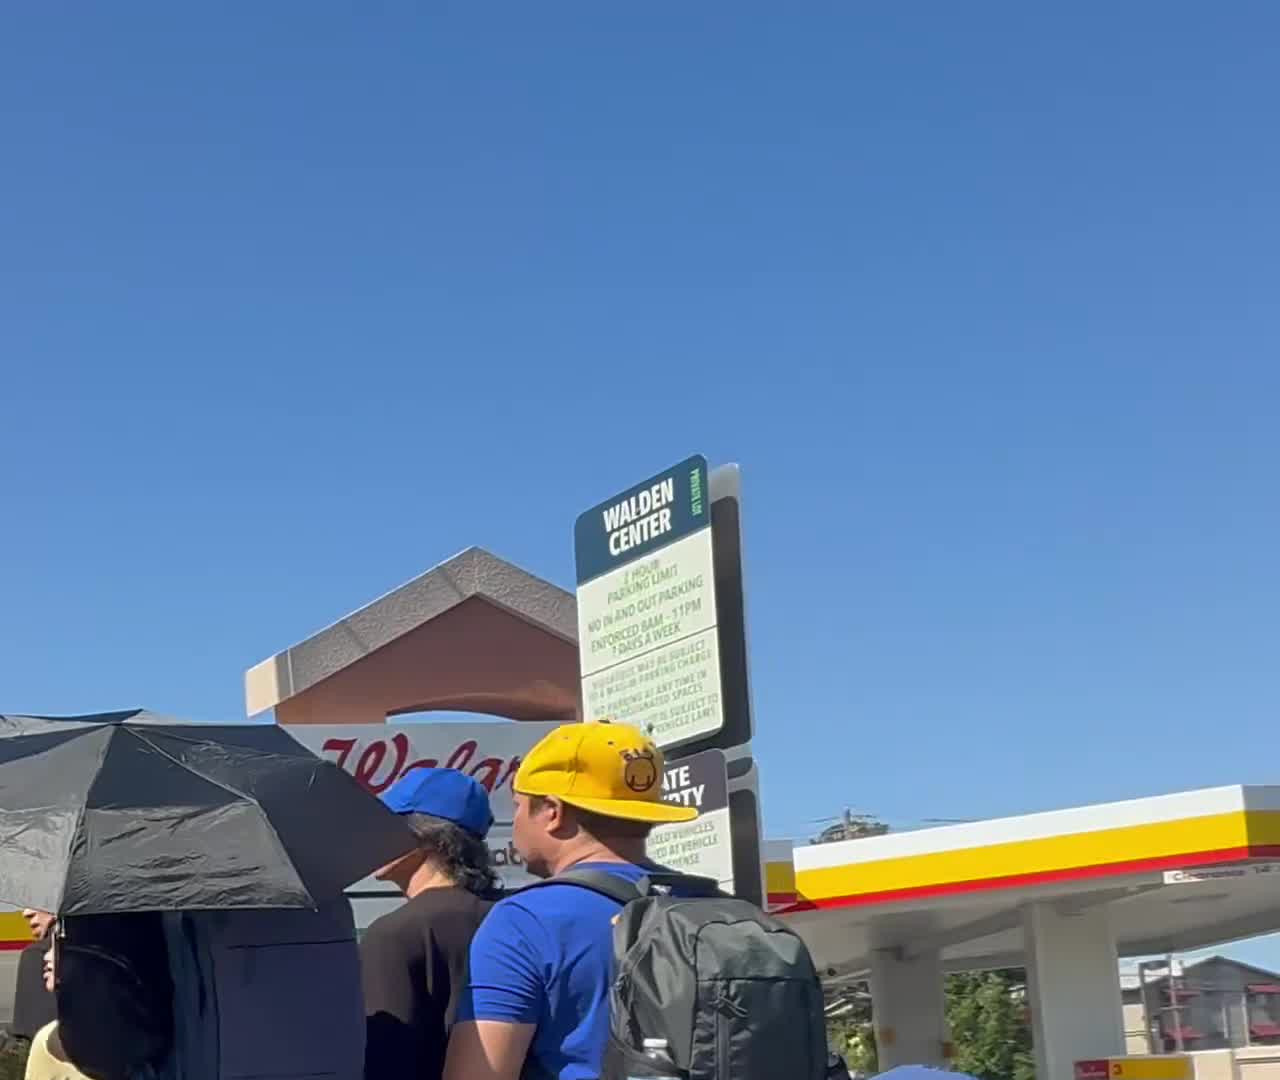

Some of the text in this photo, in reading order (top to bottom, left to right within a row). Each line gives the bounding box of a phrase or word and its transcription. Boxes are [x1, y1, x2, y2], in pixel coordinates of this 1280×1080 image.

[603, 477, 674, 533] WALDEN
[609, 508, 672, 556] CENTER
[588, 621, 601, 633] NO
[615, 604, 636, 621] AND
[638, 597, 657, 613] OUT
[658, 575, 703, 605] PARKING
[608, 564, 678, 604] PARKING LIMIT
[591, 625, 639, 653] ENFORCED
[618, 636, 644, 655] DAYS
[653, 622, 681, 642] WEEK
[1112, 1064, 1123, 1075] 3
